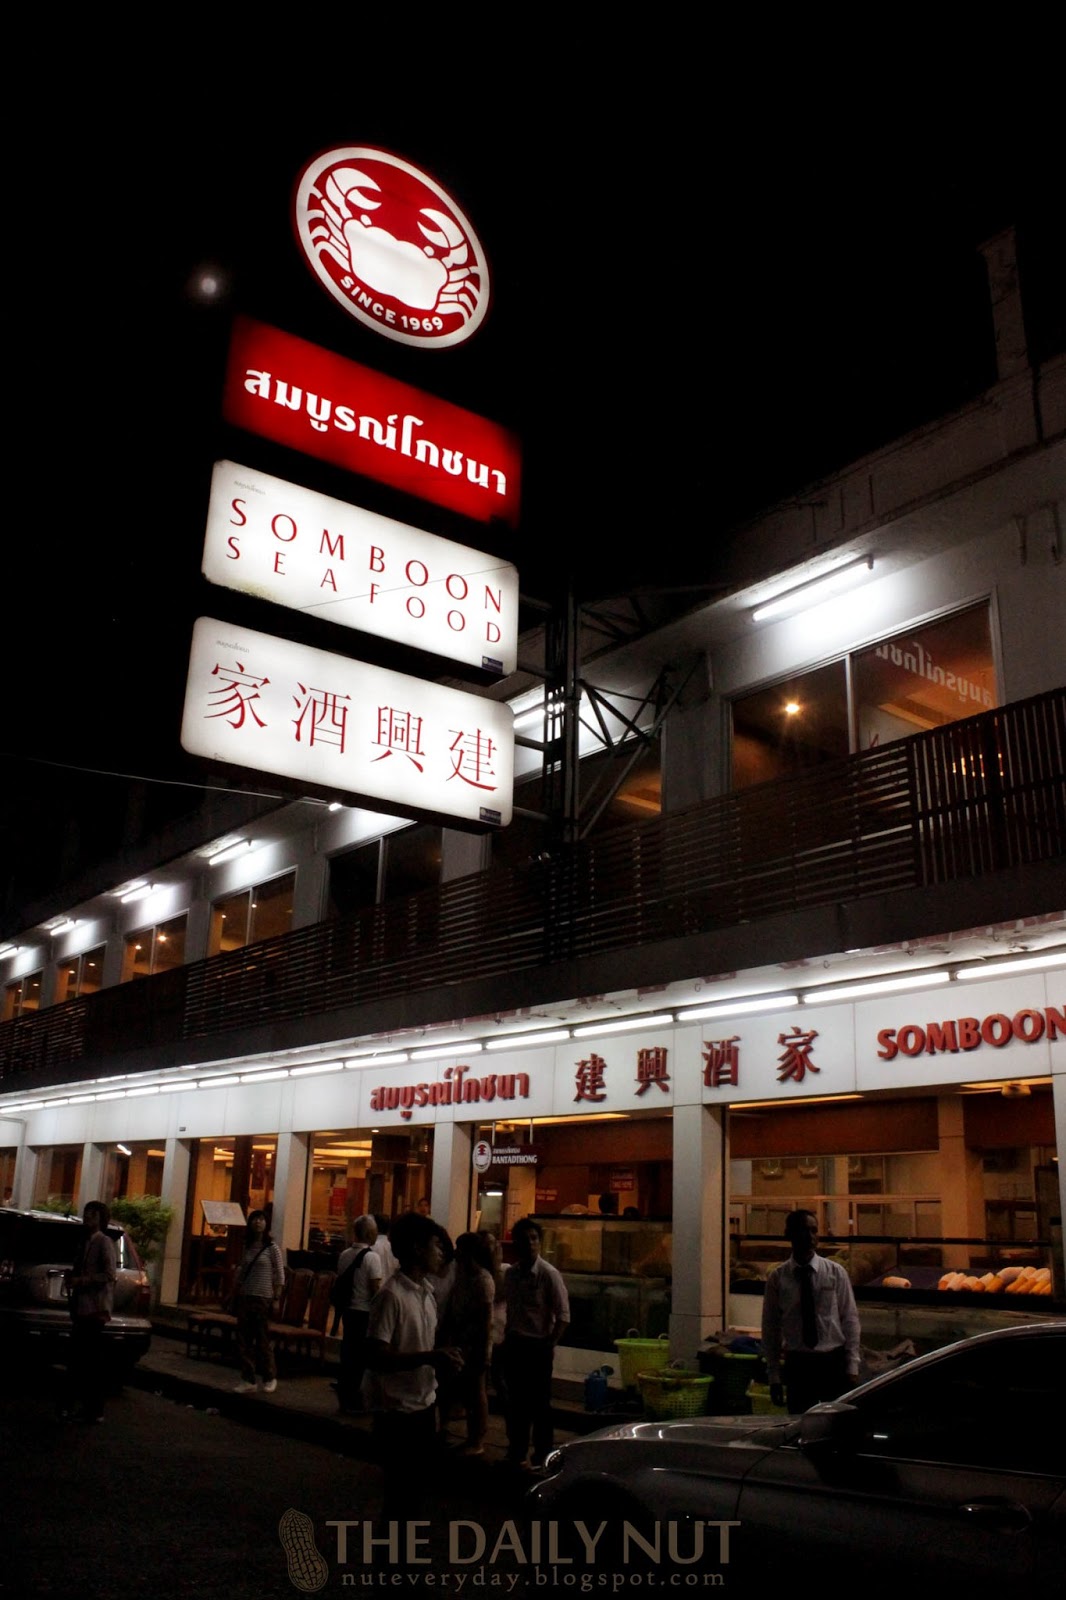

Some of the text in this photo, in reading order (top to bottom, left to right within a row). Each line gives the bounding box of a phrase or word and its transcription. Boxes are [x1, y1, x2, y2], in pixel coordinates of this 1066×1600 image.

[340, 275, 443, 332] SINCE 1969
[225, 536, 502, 643] SEAFOOD
[229, 498, 502, 614] SOMBOON
[876, 1004, 1066, 1061] SOMBOON
